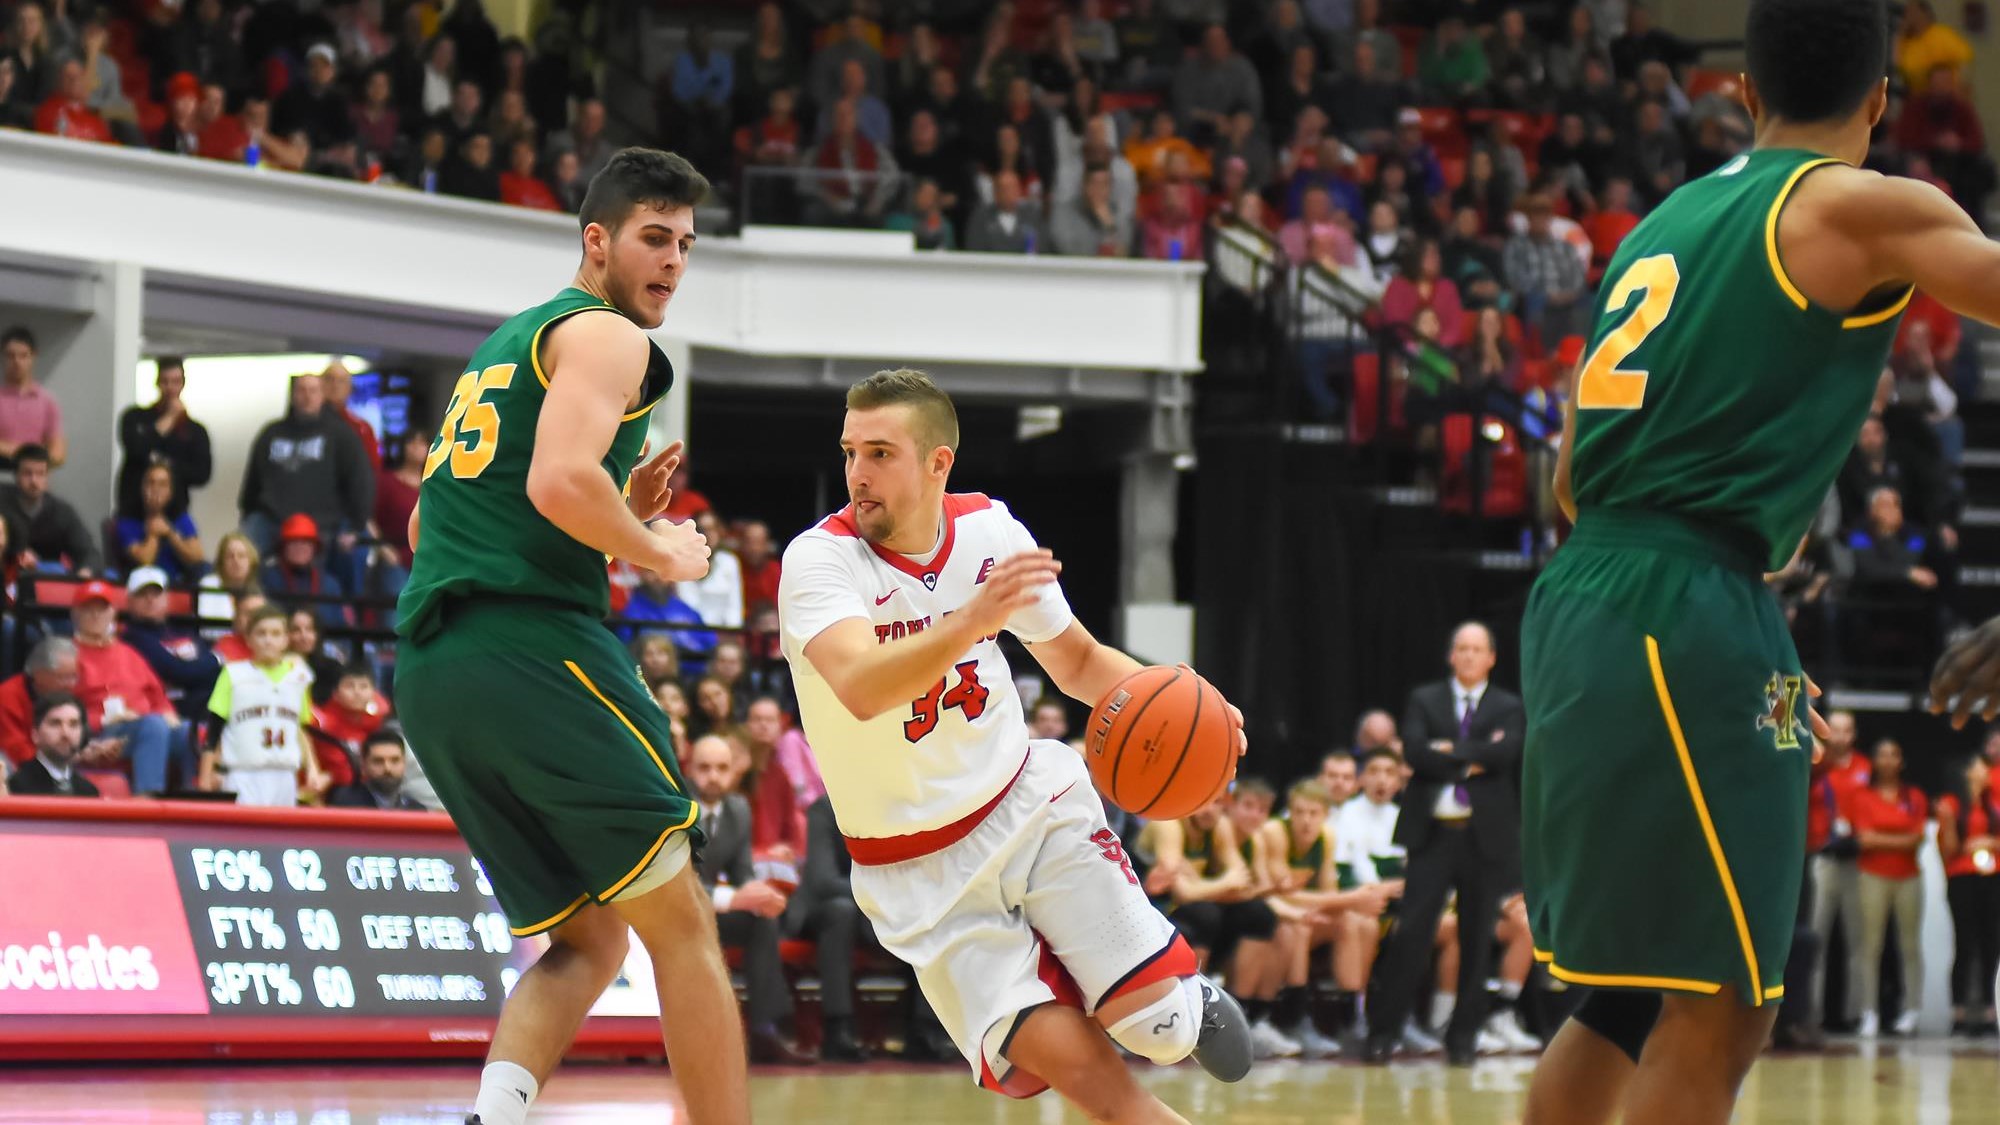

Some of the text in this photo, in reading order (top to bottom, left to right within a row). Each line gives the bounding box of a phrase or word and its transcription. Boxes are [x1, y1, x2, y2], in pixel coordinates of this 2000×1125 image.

[1577, 253, 1681, 410] 2
[421, 362, 519, 482] 35
[903, 659, 990, 744] 34
[191, 848, 327, 893] FG% 62
[346, 855, 397, 890] OFF
[207, 906, 341, 951] FT% 50
[361, 914, 413, 950] DEF
[0, 931, 160, 990] ociates
[206, 961, 355, 1008] 3PT% 60
